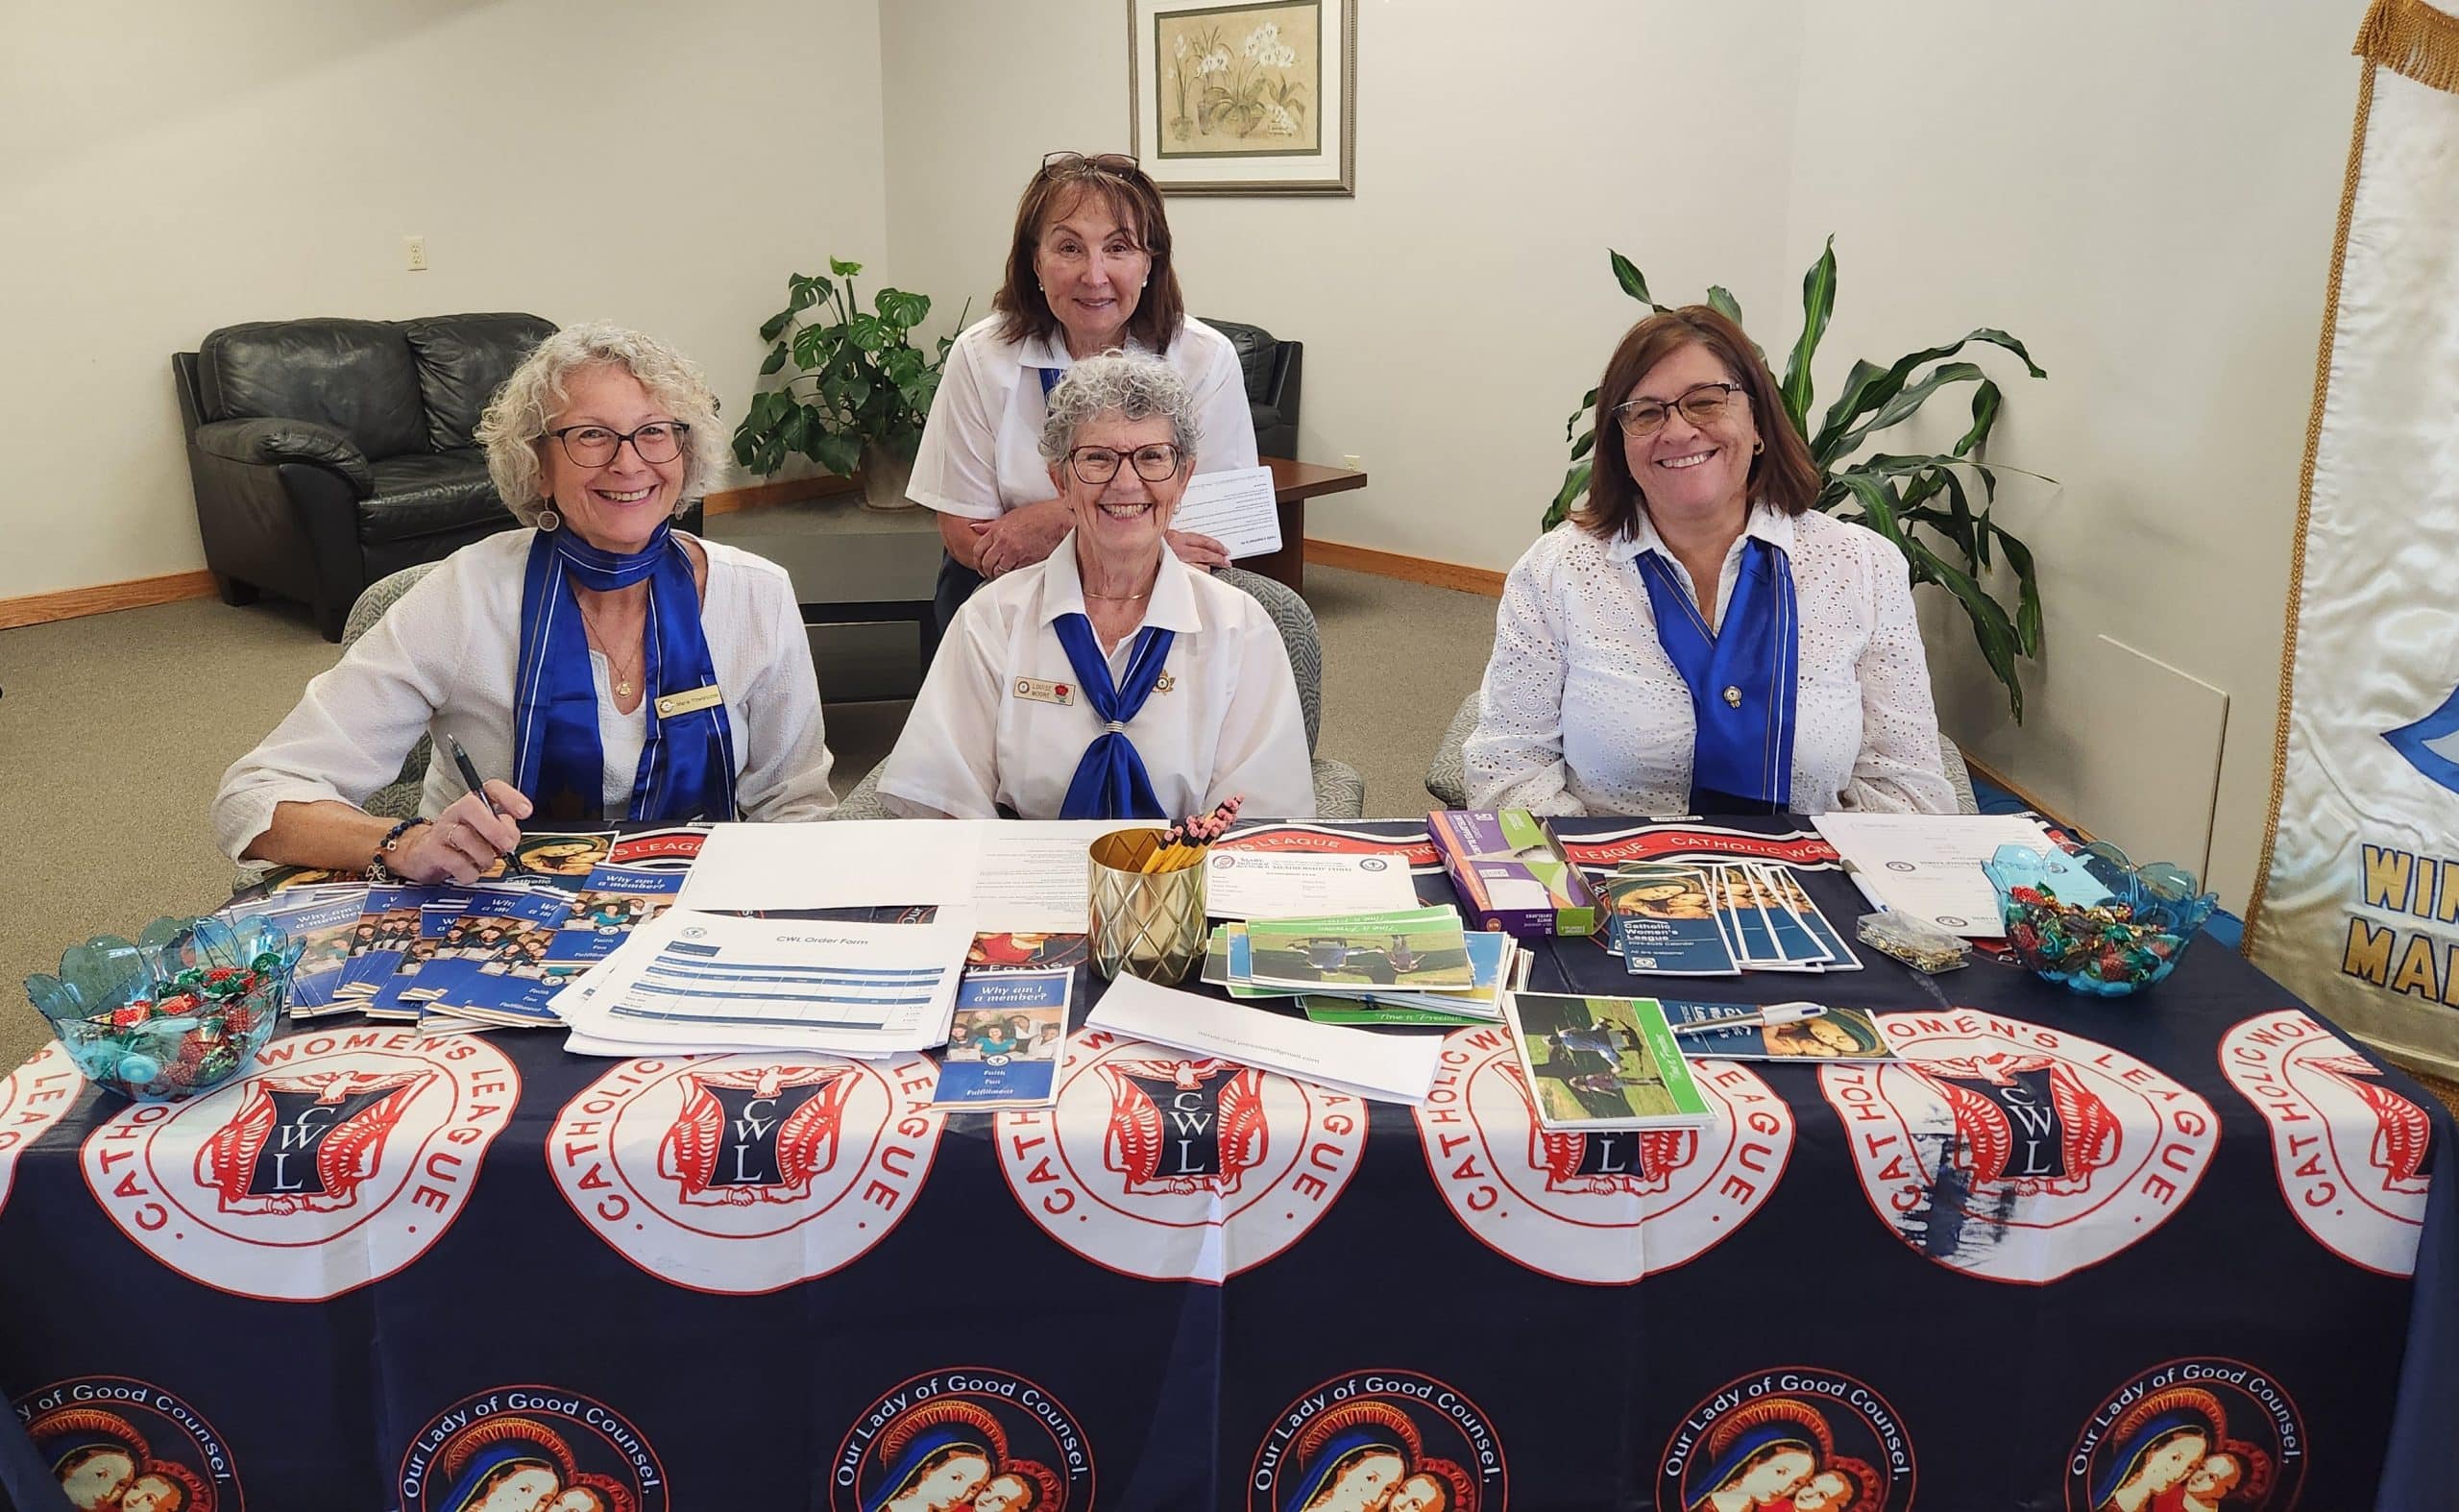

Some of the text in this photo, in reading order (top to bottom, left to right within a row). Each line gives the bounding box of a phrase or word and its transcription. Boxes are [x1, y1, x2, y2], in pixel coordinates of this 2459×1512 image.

[606, 875, 631, 884] Why
[1255, 837, 1342, 849] LEAGUE
[1574, 842, 1648, 861] LEAGUE
[1670, 837, 1782, 854] CATHOLIC
[297, 914, 329, 924] Why
[331, 907, 353, 916] am
[805, 937, 837, 945] Order
[840, 938, 869, 946] Form
[982, 987, 1010, 996] Why
[1036, 985, 1043, 993] I
[987, 992, 1048, 1003] member?
[100, 1033, 505, 1232] CATHO WOMEN'S LEAGUE
[564, 1060, 934, 1222] CATHOLIC LEAGUE
[966, 1088, 1014, 1097] Fulfillment
[1427, 1048, 1498, 1212] CATHOLIC
[1834, 1015, 2206, 1213] OMEN'S CATHOLI LEAGUE
[2233, 1046, 2337, 1207] CATHOLIC
[1014, 1094, 1354, 1216] CATH AGUE
[38, 1384, 231, 1485] of Good Counsel,
[403, 1393, 661, 1499] Our Lady of Good Counsel,
[838, 1375, 1088, 1486] Our Lady of Good Counsel,
[1254, 1377, 1501, 1492] Our Lady of Good Counsel,
[1665, 1375, 1911, 1481] Our Lady of Good Counsel,
[2072, 1364, 2301, 1476] Our Lady of Good Counsel,
